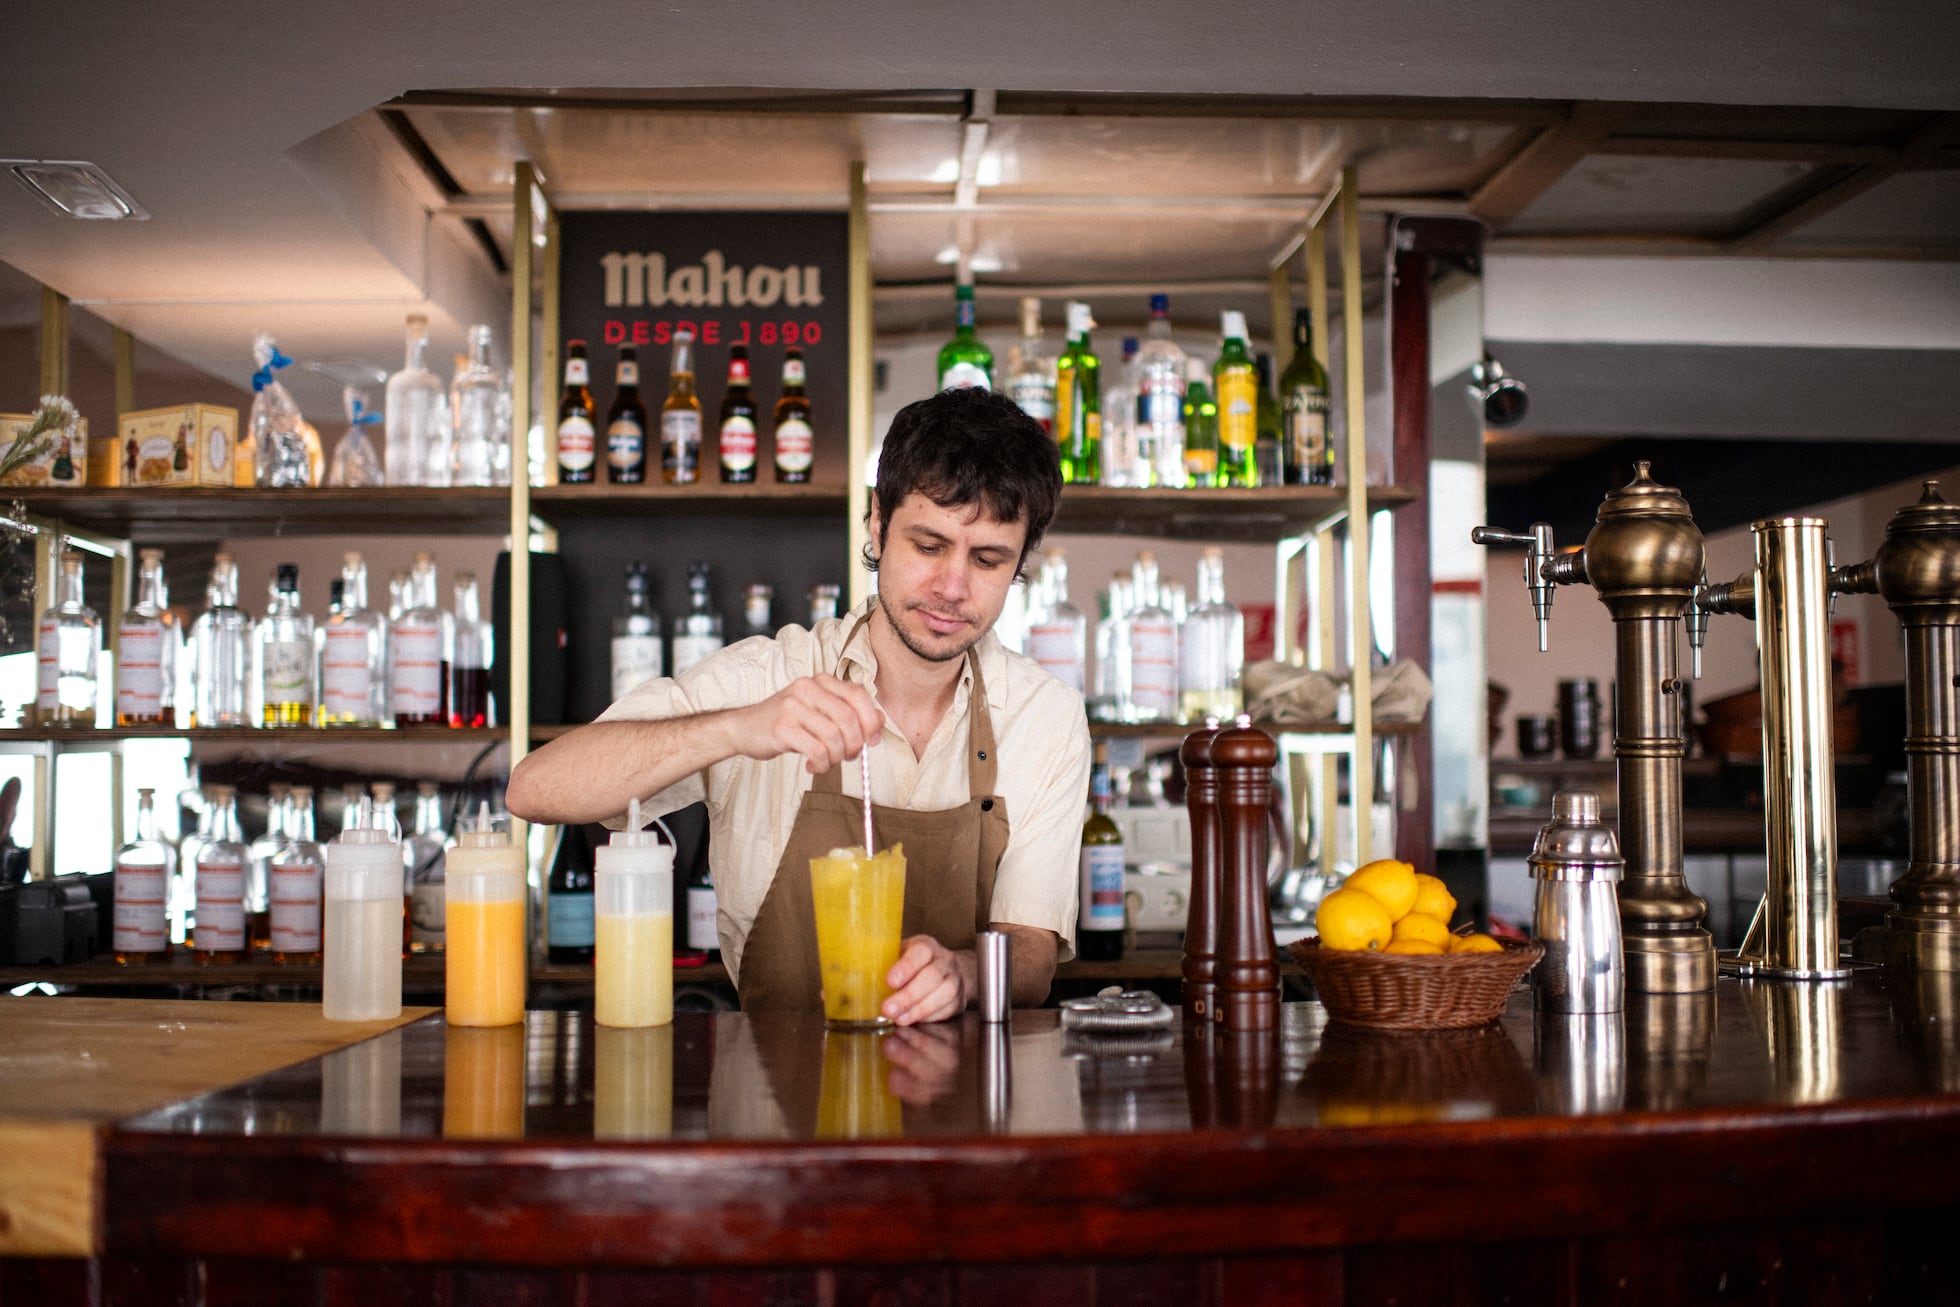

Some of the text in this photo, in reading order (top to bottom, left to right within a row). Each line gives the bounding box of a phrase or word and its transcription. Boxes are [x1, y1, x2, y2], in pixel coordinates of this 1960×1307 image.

[601, 250, 824, 306] Mahou
[605, 321, 822, 345] DESDE 1890
